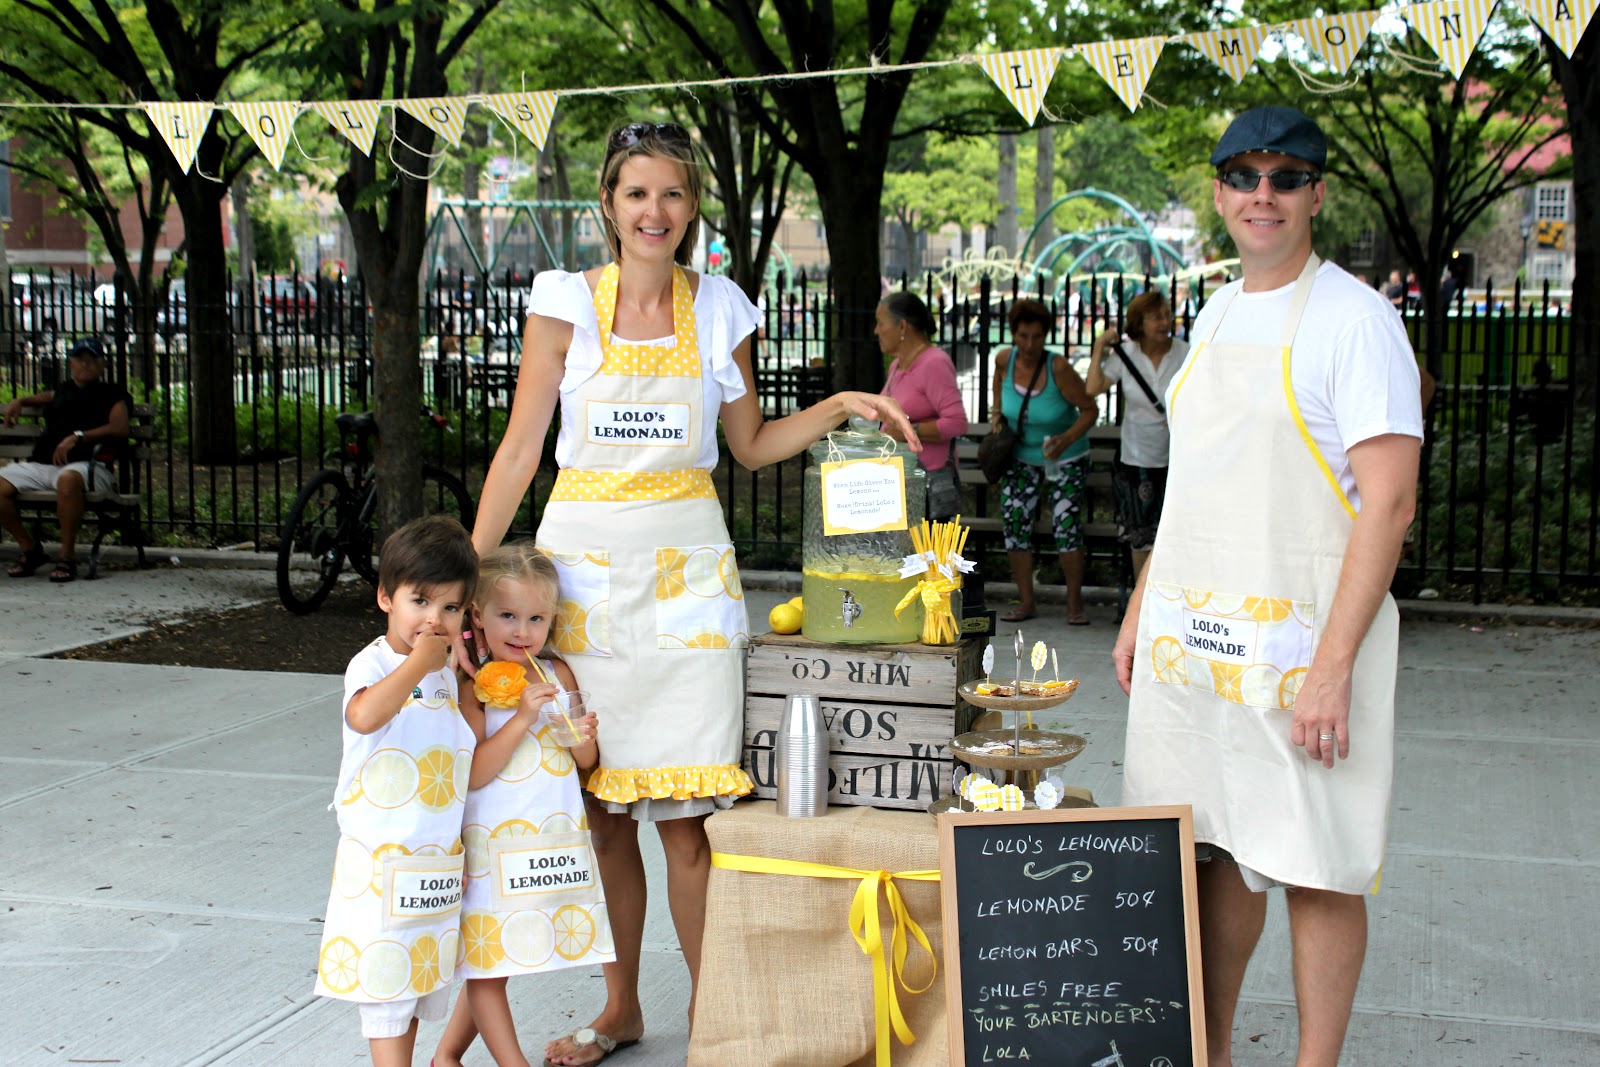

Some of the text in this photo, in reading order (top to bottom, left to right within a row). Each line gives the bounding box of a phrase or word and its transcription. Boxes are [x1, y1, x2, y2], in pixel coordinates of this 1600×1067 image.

[613, 411, 665, 423] LOLO's
[594, 426, 683, 439] LEMONADE
[1192, 618, 1230, 637] LOLO's
[1185, 633, 1246, 657] LEMONADE
[846, 661, 912, 687] MFR
[821, 706, 898, 741] SOA
[751, 730, 947, 801] MILFD
[981, 834, 1159, 856] LOLO'S LEMONADE
[529, 855, 576, 870] LOLO's
[419, 877, 460, 892] LOLO's
[509, 870, 590, 890] LEMONADE
[399, 892, 461, 909] LEMONAD
[977, 893, 1091, 918] LEMONADE
[978, 945, 1037, 961] LEMON
[1046, 938, 1099, 959] BARS
[979, 980, 1122, 1002] SMILES FREE
[973, 1013, 1017, 1033] YOUR
[982, 1044, 1031, 1062] LOLA
